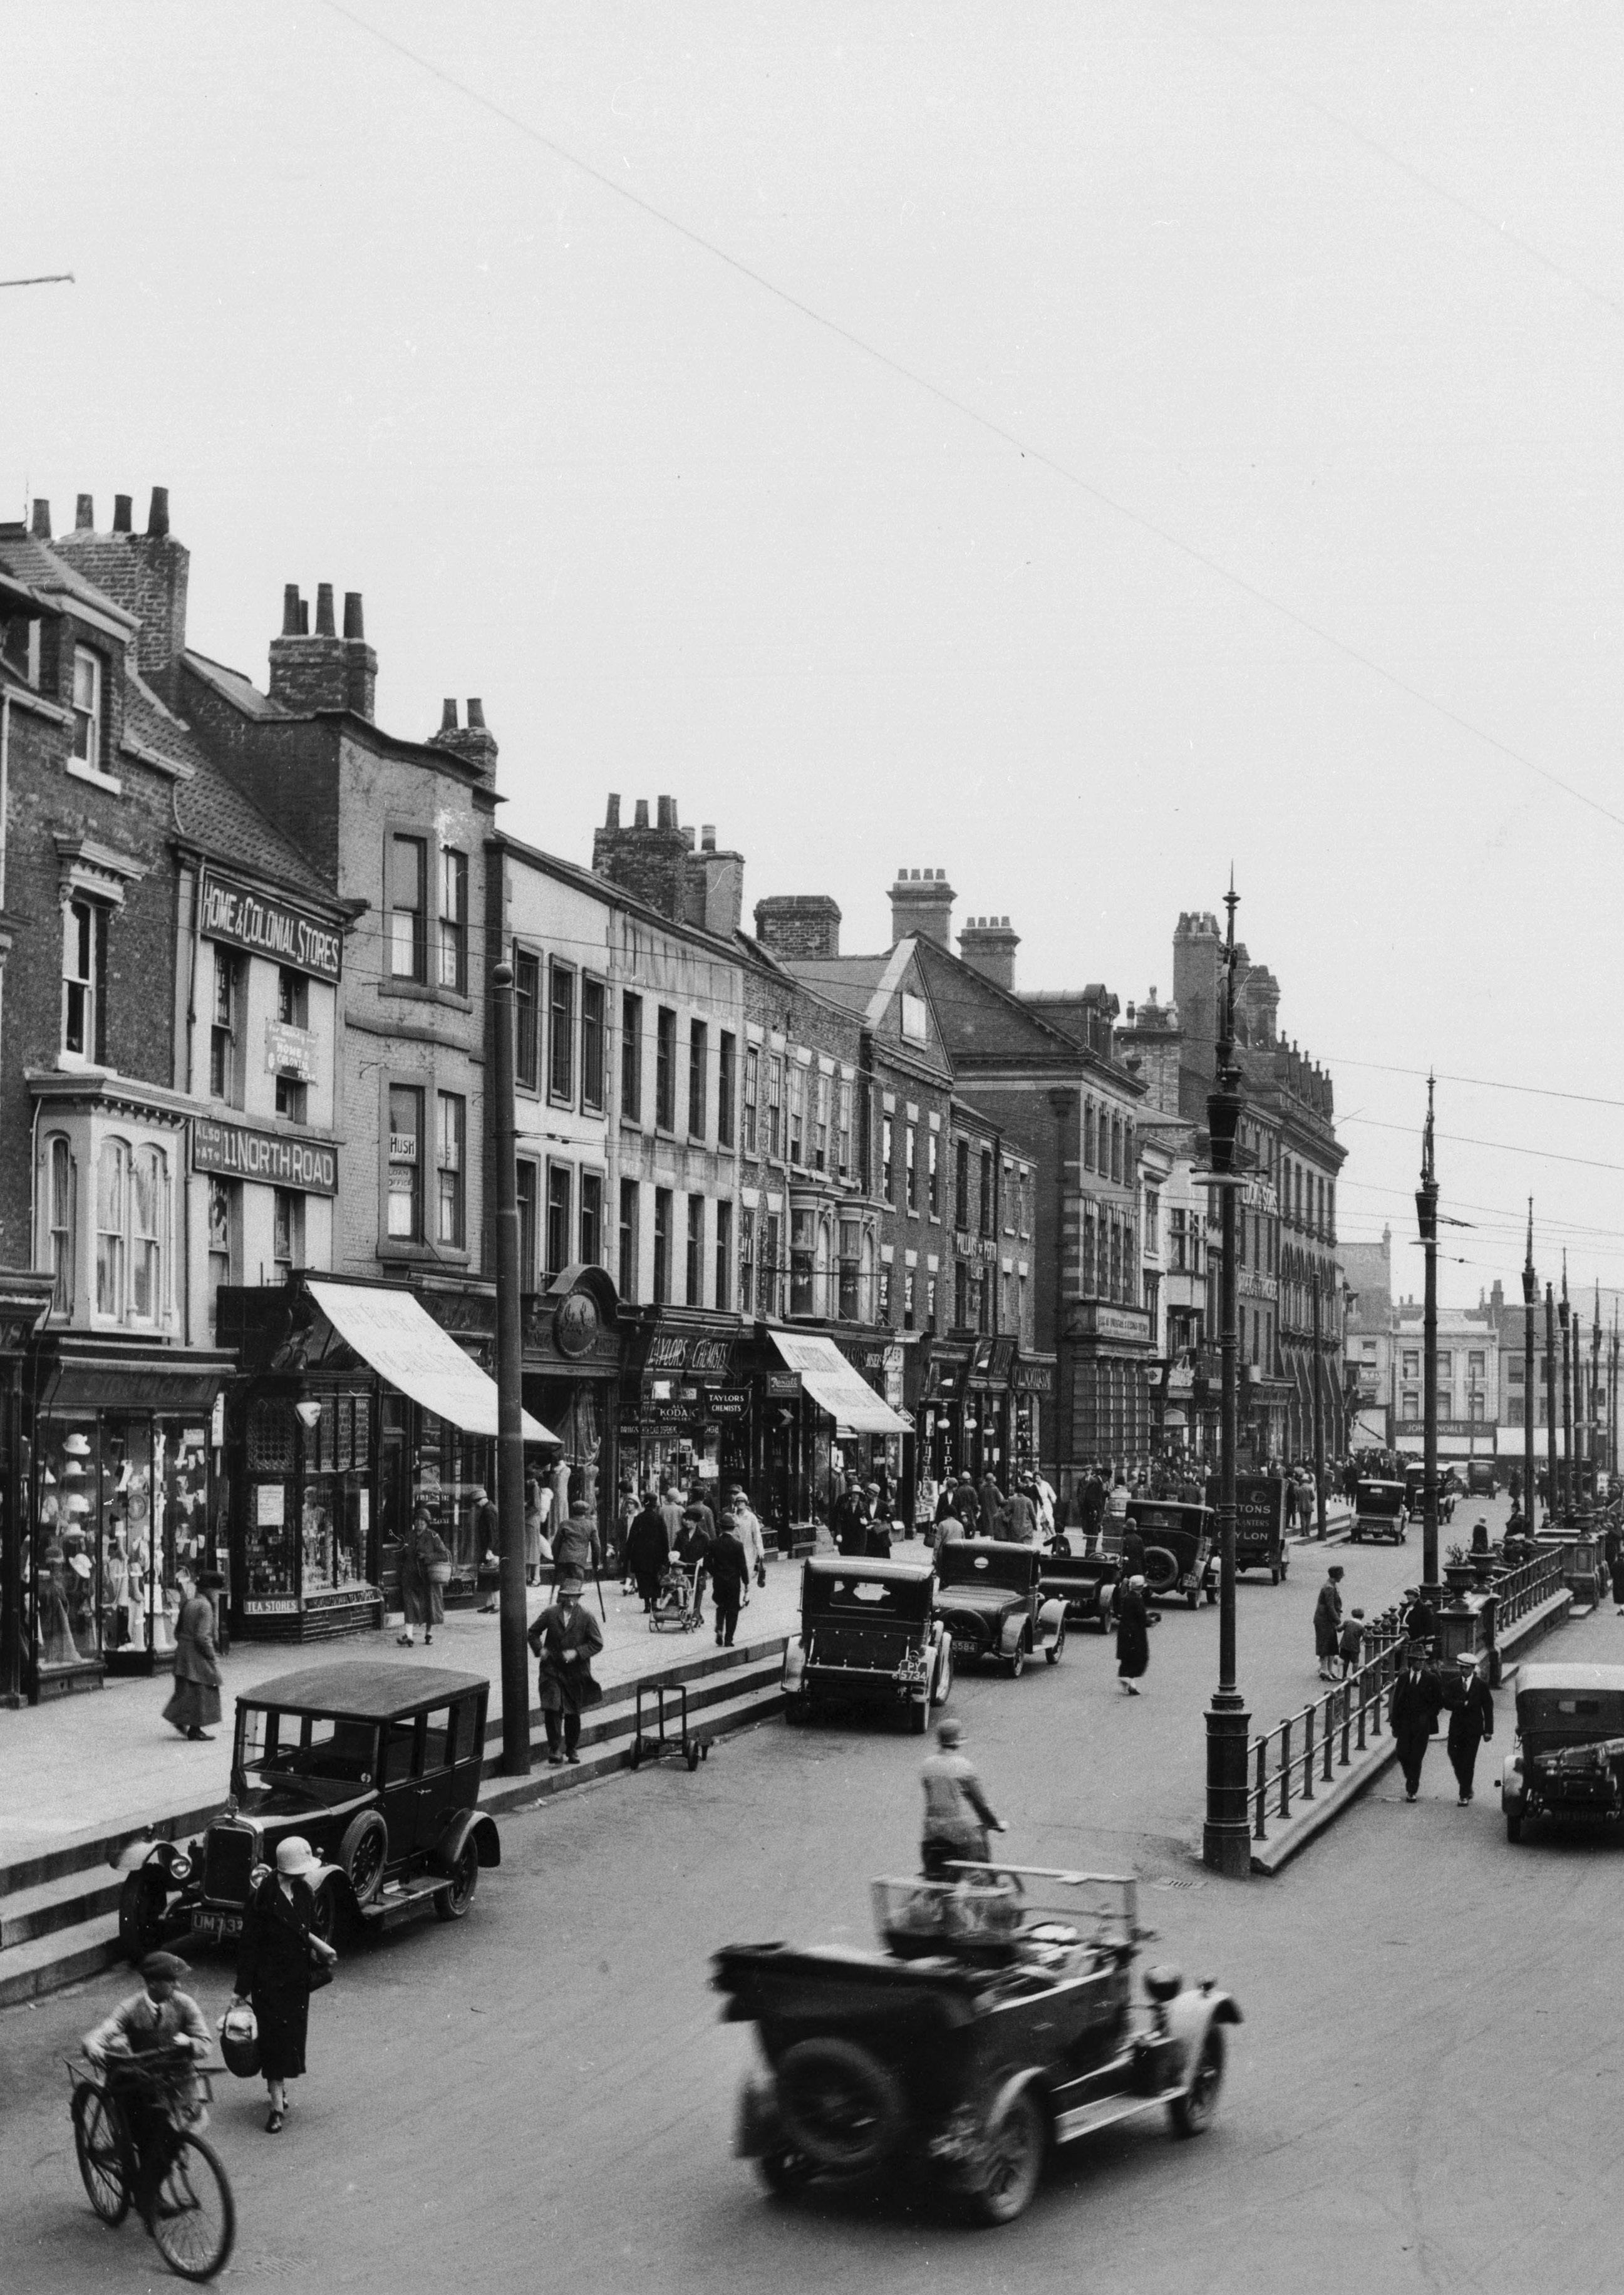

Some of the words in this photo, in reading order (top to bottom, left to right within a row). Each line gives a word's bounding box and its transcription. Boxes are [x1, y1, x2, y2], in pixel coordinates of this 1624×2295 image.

[202, 880, 237, 933] HOME
[235, 903, 244, 936] &
[243, 897, 296, 957] COLONIAL
[297, 920, 339, 973] STORES
[195, 1120, 220, 1142] ALSO
[390, 1137, 415, 1154] HUSH
[237, 1131, 290, 1178] NORTH
[292, 1144, 333, 1186] ROAD
[388, 1178, 413, 1186] OFFICE
[648, 1337, 688, 1366] TAYLORS
[692, 1339, 728, 1369] CHEMISTS
[1437, 1424, 1463, 1433] NOBLE
[247, 1602, 263, 1612] TEA
[266, 1600, 296, 1612] STORES
[908, 1662, 921, 1671] PY
[901, 1670, 926, 1680] 5734
[194, 1914, 214, 1930] UM
